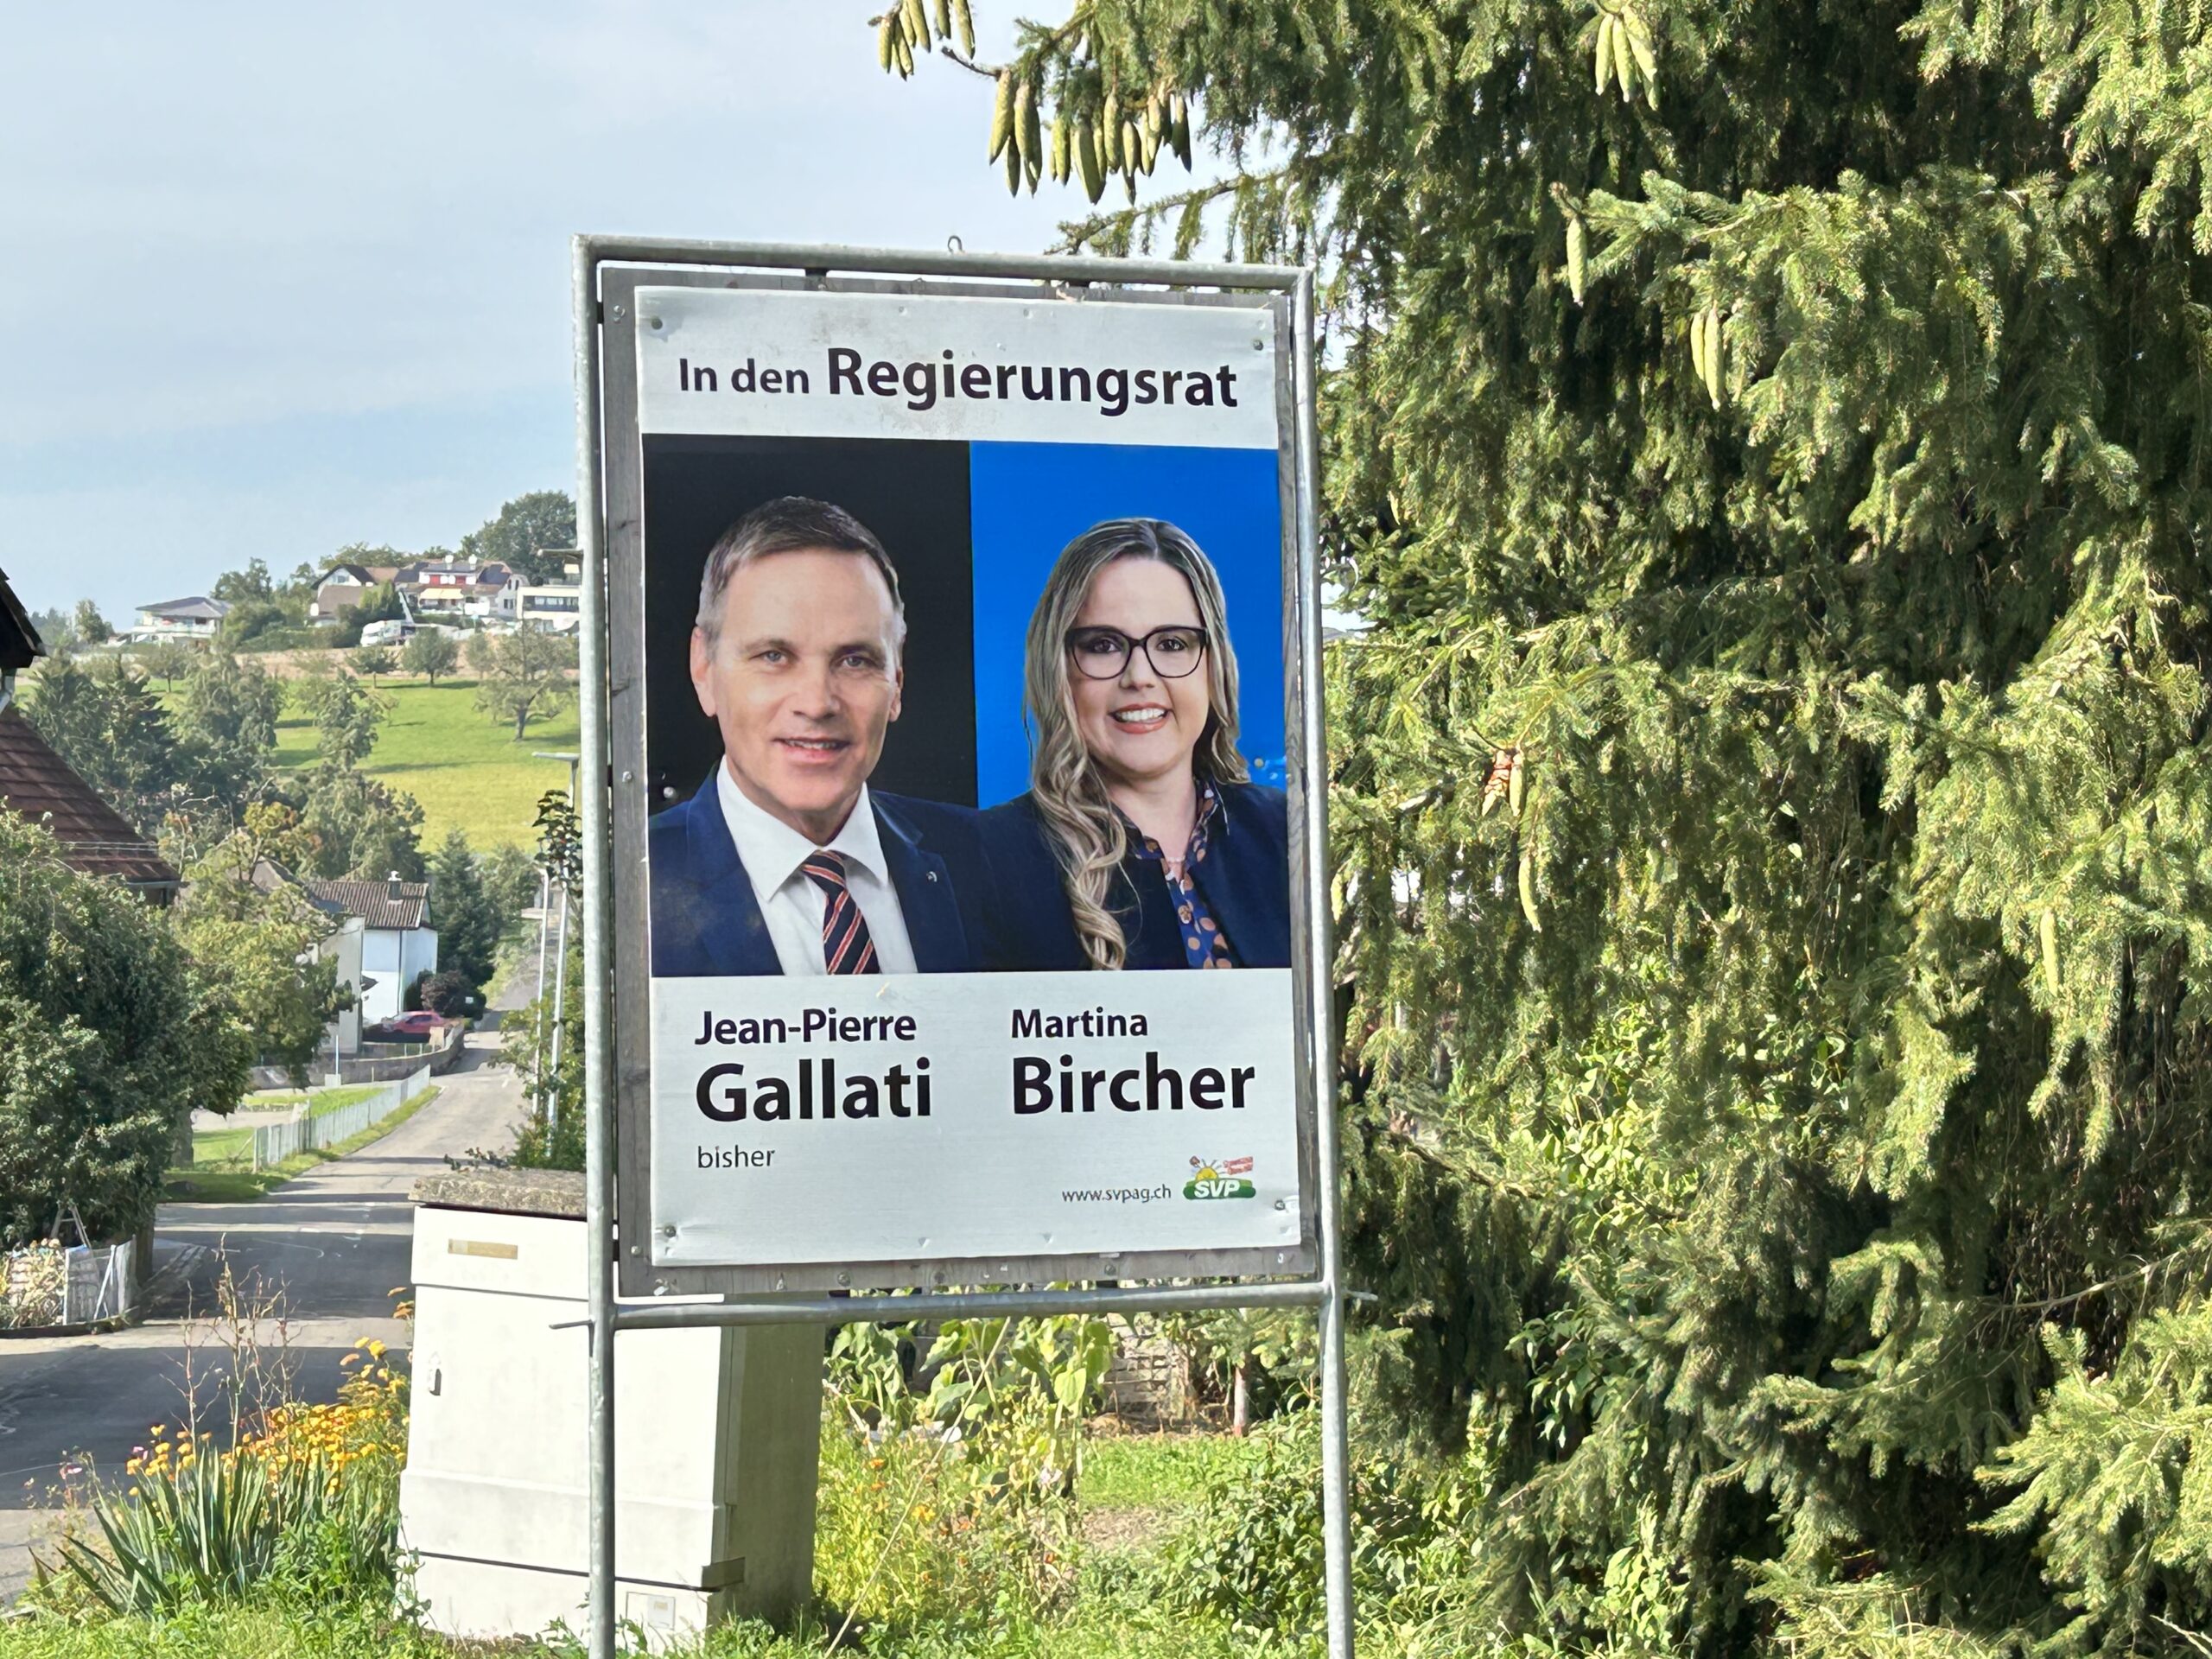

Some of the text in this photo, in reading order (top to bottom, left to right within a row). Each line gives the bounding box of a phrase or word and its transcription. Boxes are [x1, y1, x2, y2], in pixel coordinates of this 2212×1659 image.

[679, 347, 1239, 417] In den Regierungsrat
[695, 1007, 918, 1046] Jean-Pierre
[1011, 1006, 1149, 1039] Martina
[696, 1056, 931, 1122] Gallati
[1013, 1051, 1256, 1116] Bircher
[697, 1144, 776, 1169] bisher
[1062, 1184, 1173, 1205] www.svpag.ch
[1194, 1179, 1241, 1198] SVP
